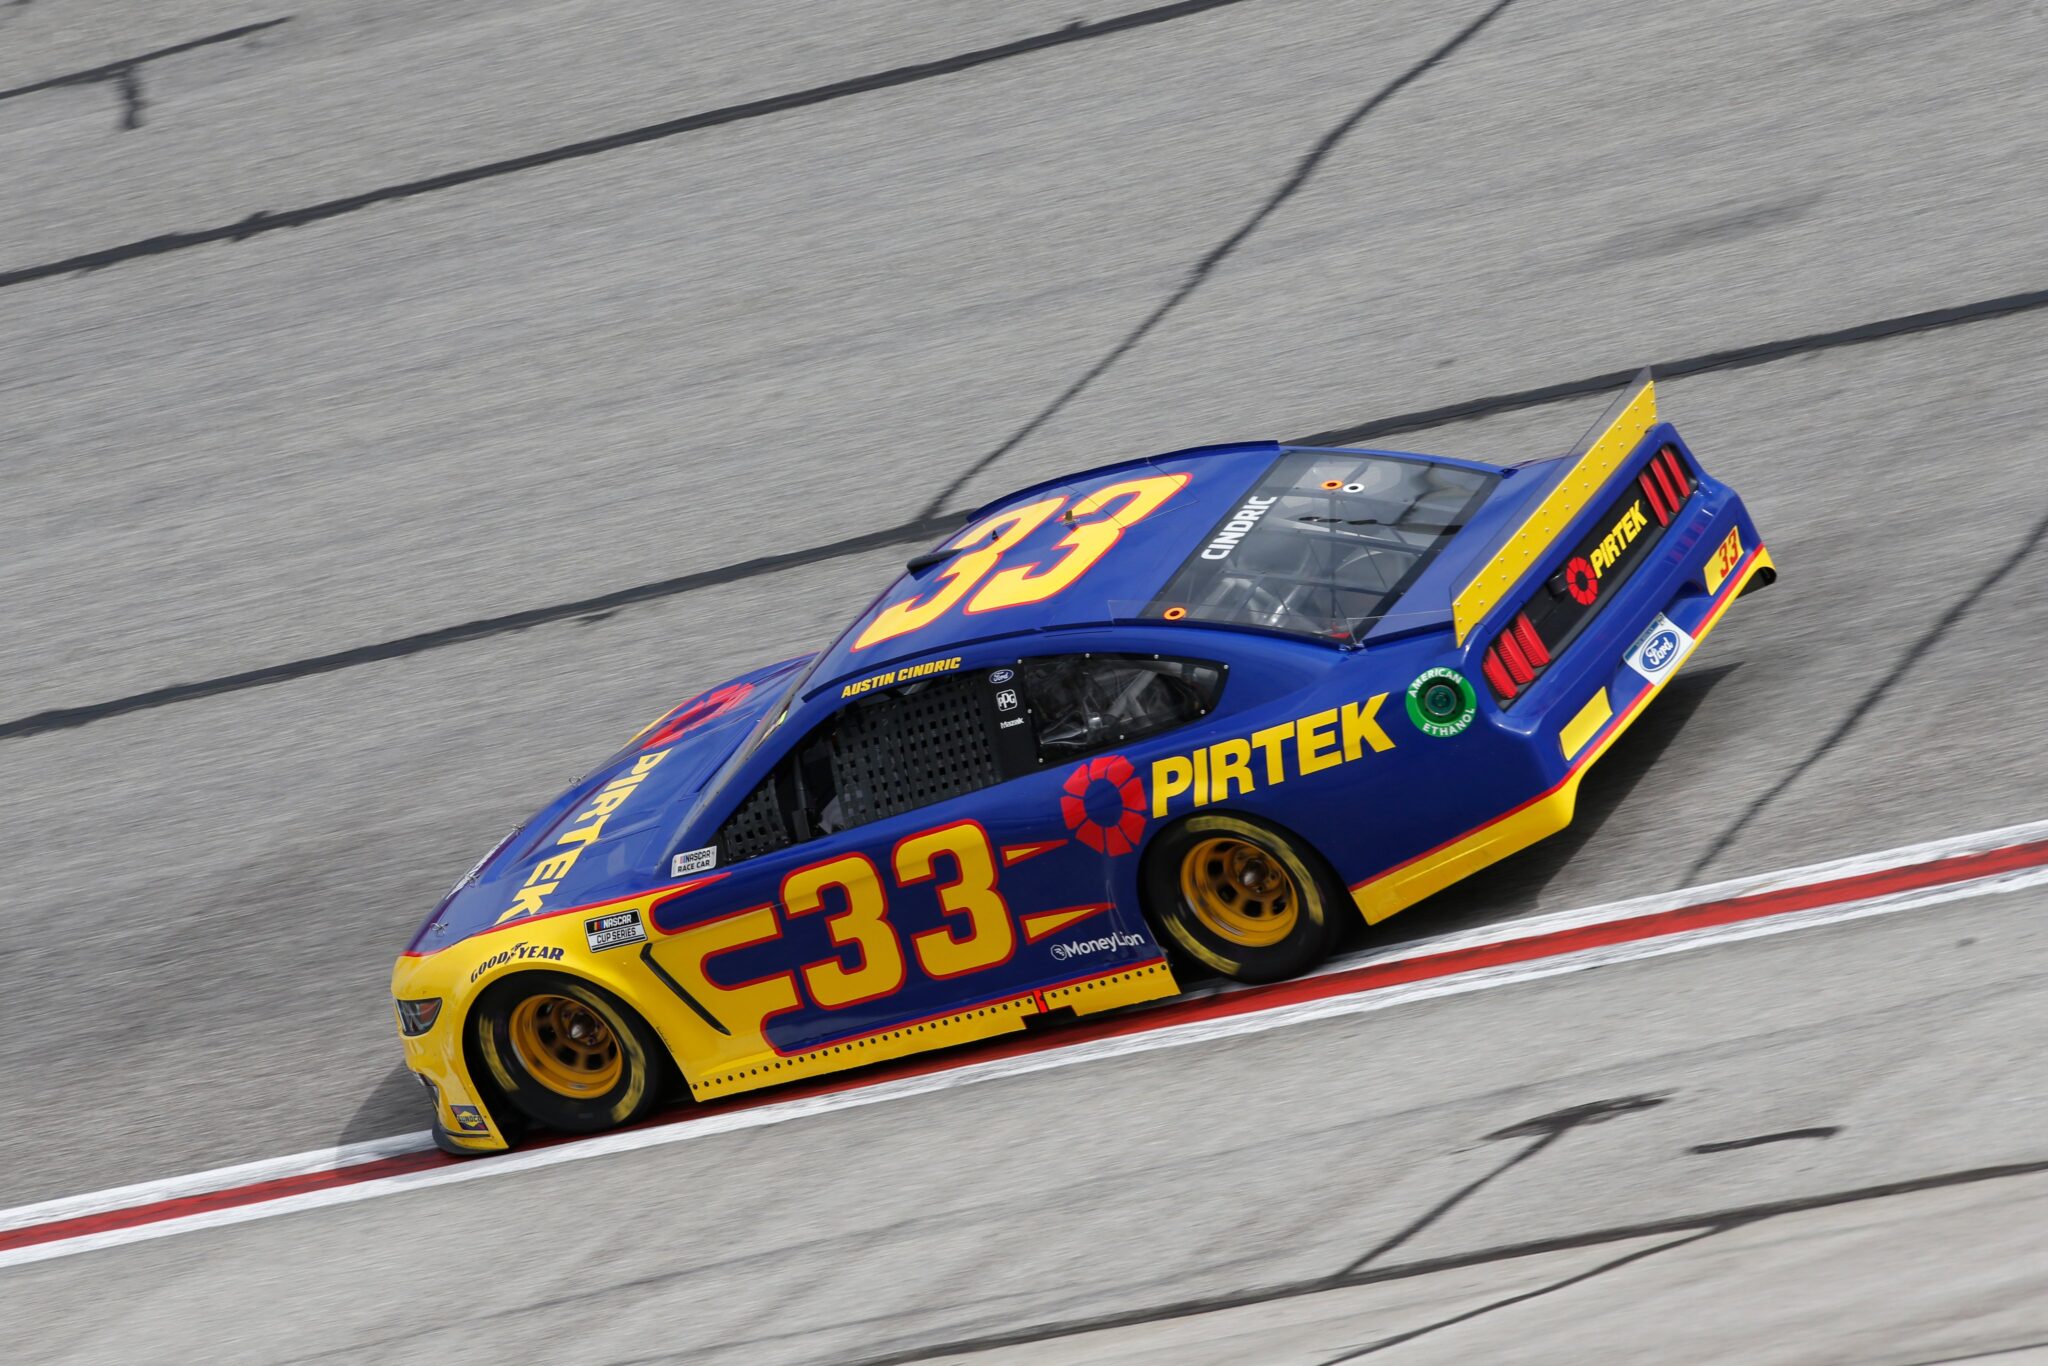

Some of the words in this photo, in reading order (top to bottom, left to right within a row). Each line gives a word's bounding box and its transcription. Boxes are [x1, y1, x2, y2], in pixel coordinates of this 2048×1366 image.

[1200, 495, 1277, 561] CINDRIC
[1589, 499, 1648, 579] PIRTEK
[850, 472, 1193, 653] 33
[1717, 530, 1740, 579] 33
[1645, 636, 1673, 665] Ford
[841, 671, 895, 699] AUSTIN
[897, 657, 962, 681] CINDRIC
[1408, 668, 1463, 698] AMERICAN
[998, 692, 1016, 709] PPG
[1000, 717, 1024, 729] Mazak
[1423, 708, 1475, 736] ETHANOL
[1151, 692, 1396, 819] PIRTEK
[494, 748, 673, 926] PIRTEK
[677, 862, 695, 873] RACE
[696, 859, 710, 870] CAR
[684, 849, 711, 864] NASCAR
[603, 914, 632, 929] NASCAR
[781, 819, 1017, 1011] 33
[596, 930, 611, 944] CUP
[612, 927, 637, 941] SERIES
[1066, 931, 1145, 958] MoneyLion
[471, 943, 564, 983] GOODYEAR
